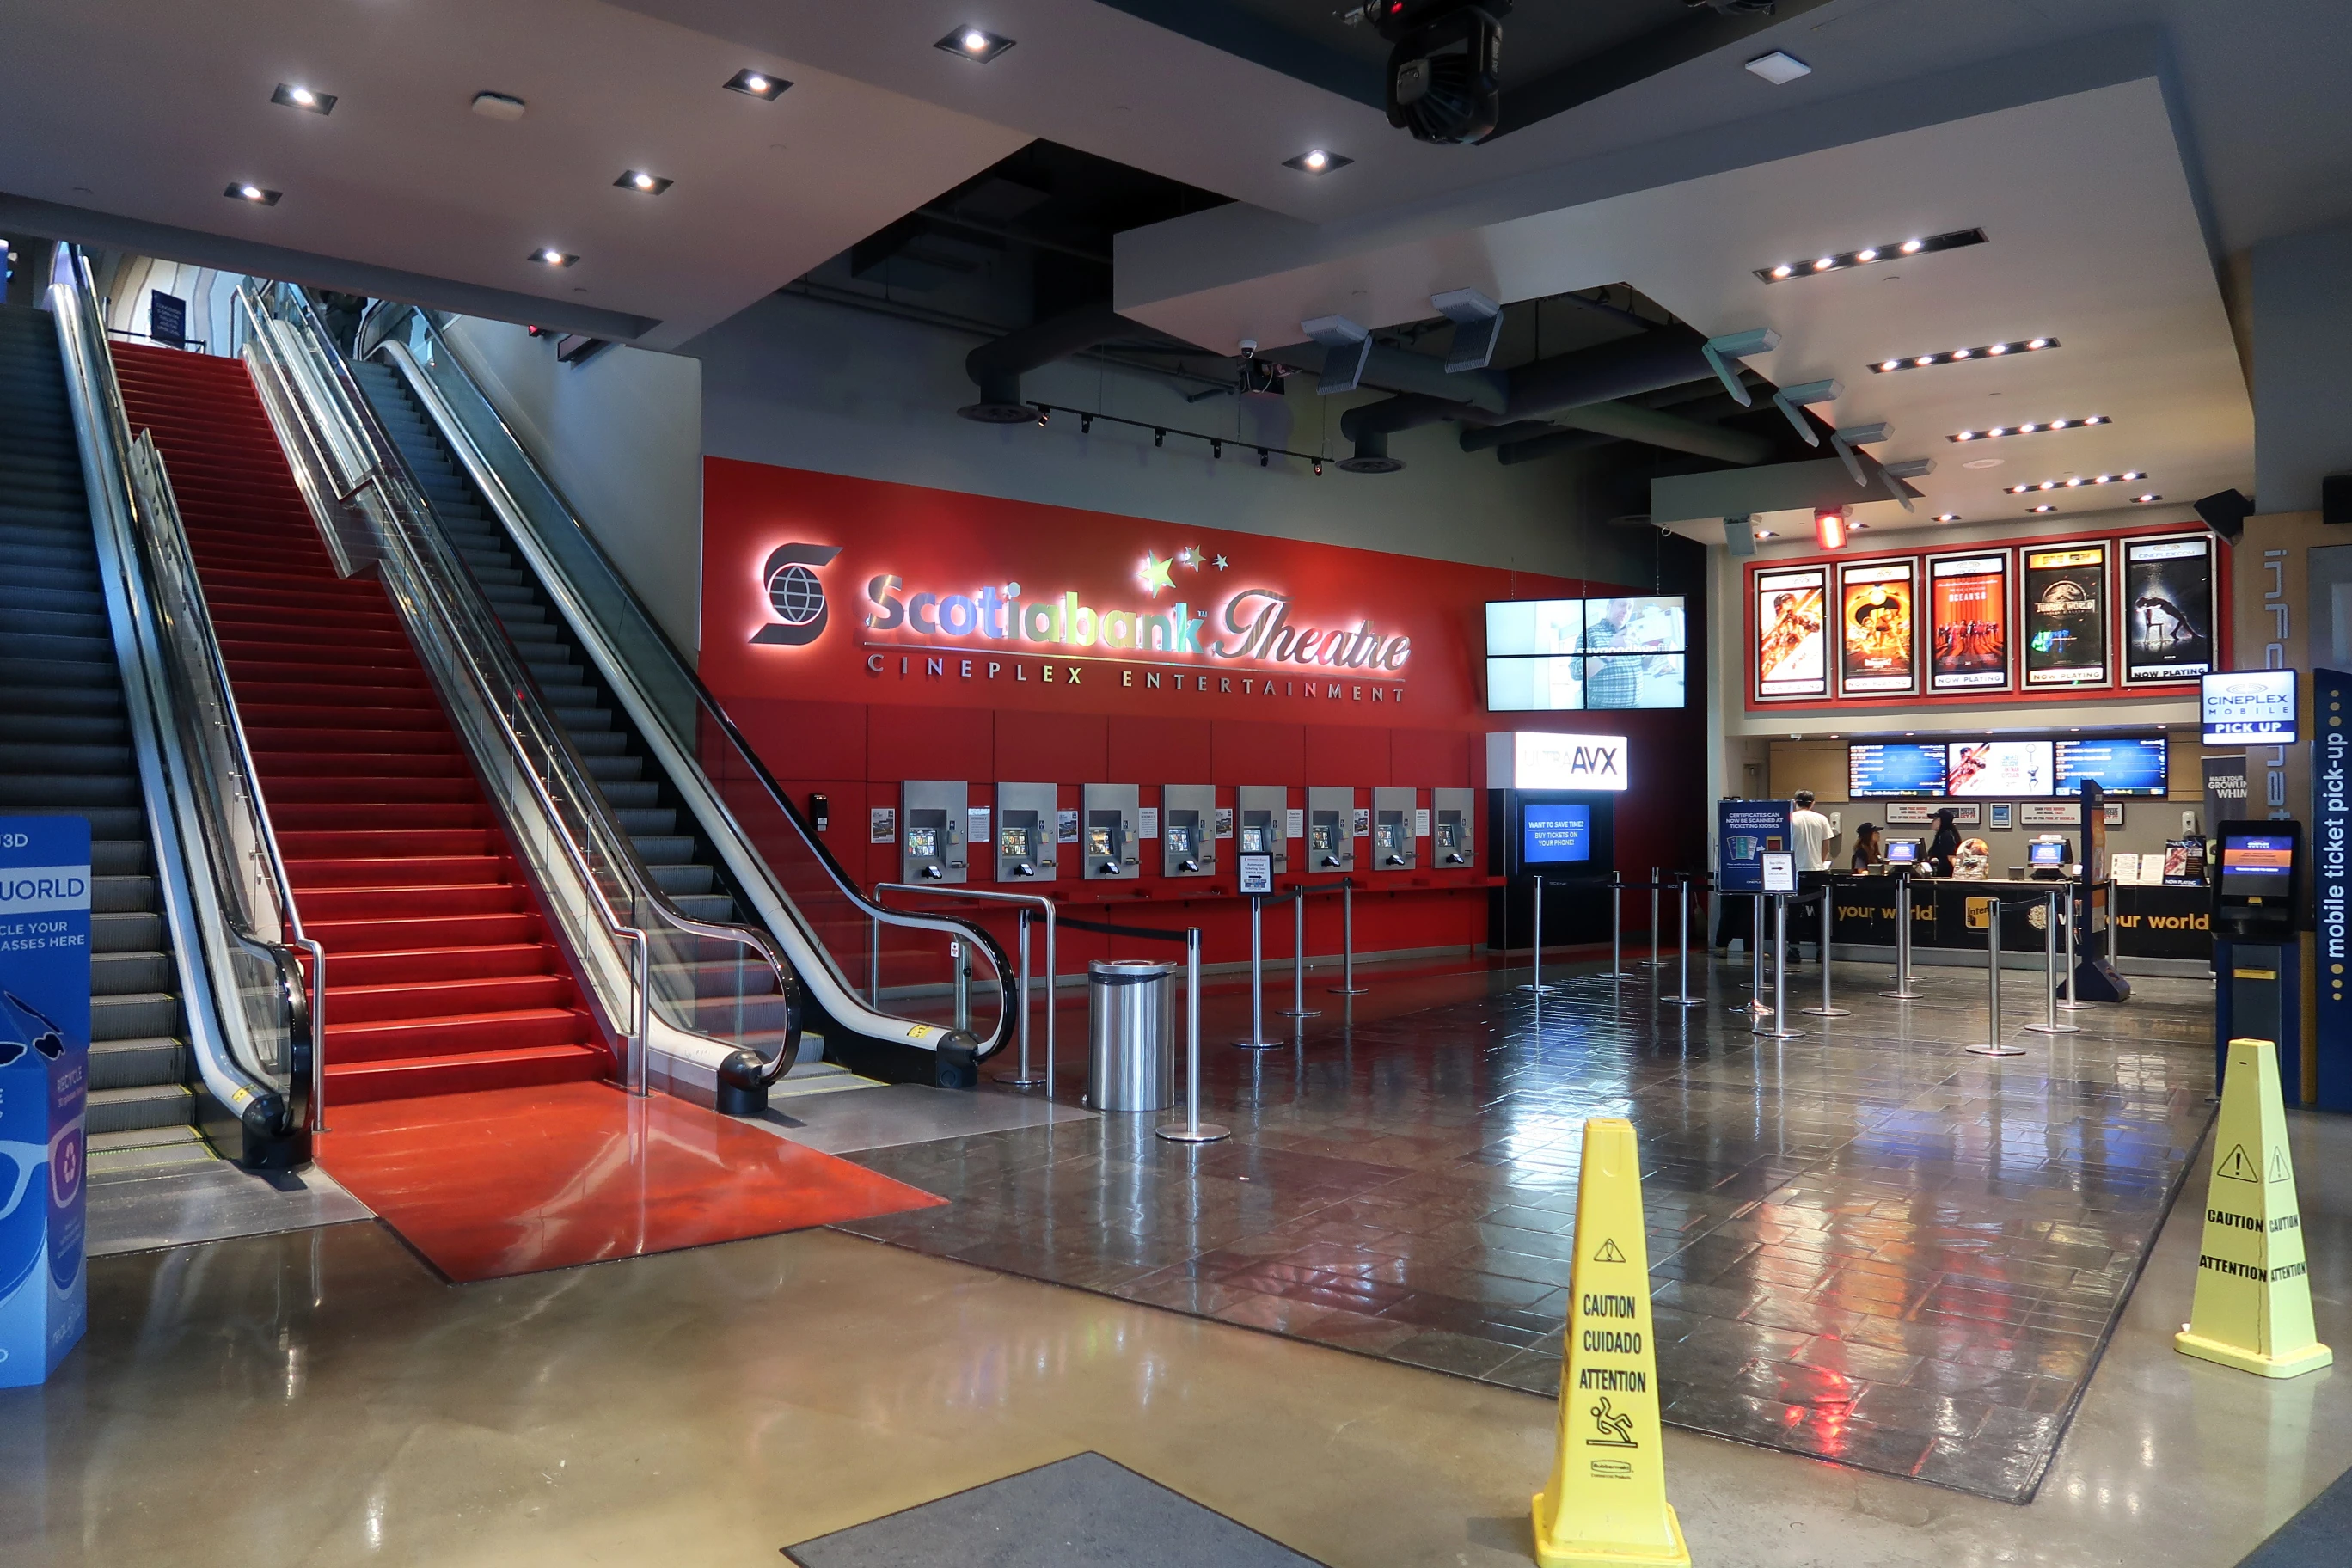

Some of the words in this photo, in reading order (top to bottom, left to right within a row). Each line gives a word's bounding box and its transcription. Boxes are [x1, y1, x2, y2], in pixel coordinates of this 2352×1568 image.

[1948, 591, 1981, 602] OCEAN'S
[1981, 591, 1987, 600] 8
[2067, 599, 2095, 612] WORLD
[865, 574, 1205, 654] Scotiabank
[1212, 589, 1412, 671] Theatre
[867, 653, 1082, 685] CINEPLEX
[1122, 671, 1404, 703] ENTERTAINMENT
[2163, 667, 2205, 677] PLAYING
[2207, 695, 2288, 706] CINEPLEX
[2208, 707, 2289, 715] MOBILE
[2215, 723, 2254, 733] PICK
[2258, 722, 2282, 732] UP
[1571, 746, 1618, 775] AVX
[2323, 732, 2349, 812] pick-up
[0, 833, 28, 848] 3D
[2323, 818, 2345, 878] ticket
[1838, 905, 1876, 921] your
[2148, 913, 2210, 930] world
[2324, 885, 2345, 958] mobile
[29, 921, 68, 934] YOUR
[50, 934, 85, 947] HERE
[2207, 1209, 2263, 1234] CAUTION
[2269, 1214, 2300, 1234] CAUTION
[2199, 1254, 2268, 1283] ATTENTION
[2270, 1260, 2307, 1283] ATTENTION
[1583, 1294, 1636, 1320] CAUTION
[1583, 1330, 1642, 1355] CUIDADO
[1580, 1368, 1646, 1393] ATTENTION
